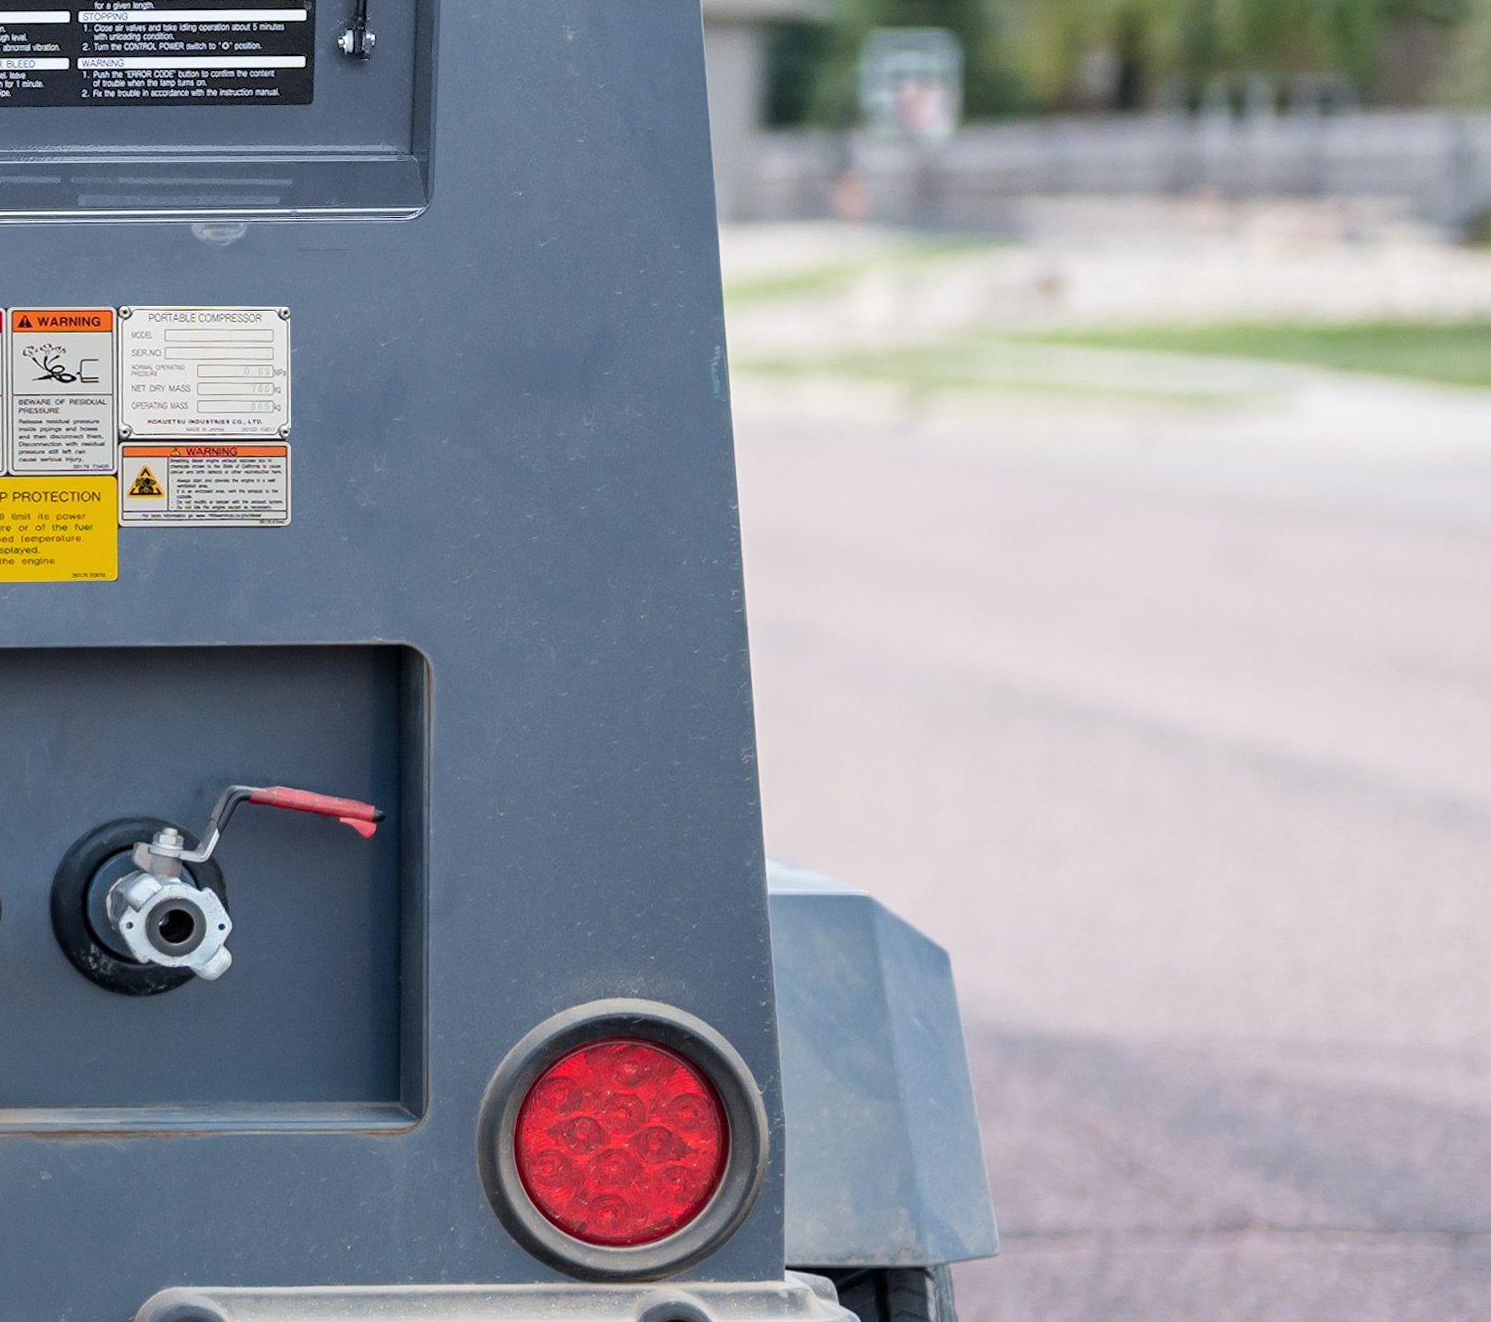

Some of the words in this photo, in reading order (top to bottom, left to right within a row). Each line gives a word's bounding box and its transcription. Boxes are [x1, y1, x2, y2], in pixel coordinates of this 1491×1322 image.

[83, 13, 128, 21] STOPPING
[6, 60, 36, 68] BLEED
[37, 317, 101, 327] WARNING
[148, 313, 196, 323] PORTABLE
[198, 313, 262, 323] COMPRESSOR
[131, 331, 152, 340] MODEL
[186, 447, 238, 455] WARNING
[13, 490, 101, 504] PROTECTION
[56, 513, 86, 521] power
[35, 523, 45, 531] of
[75, 523, 93, 531] fuel
